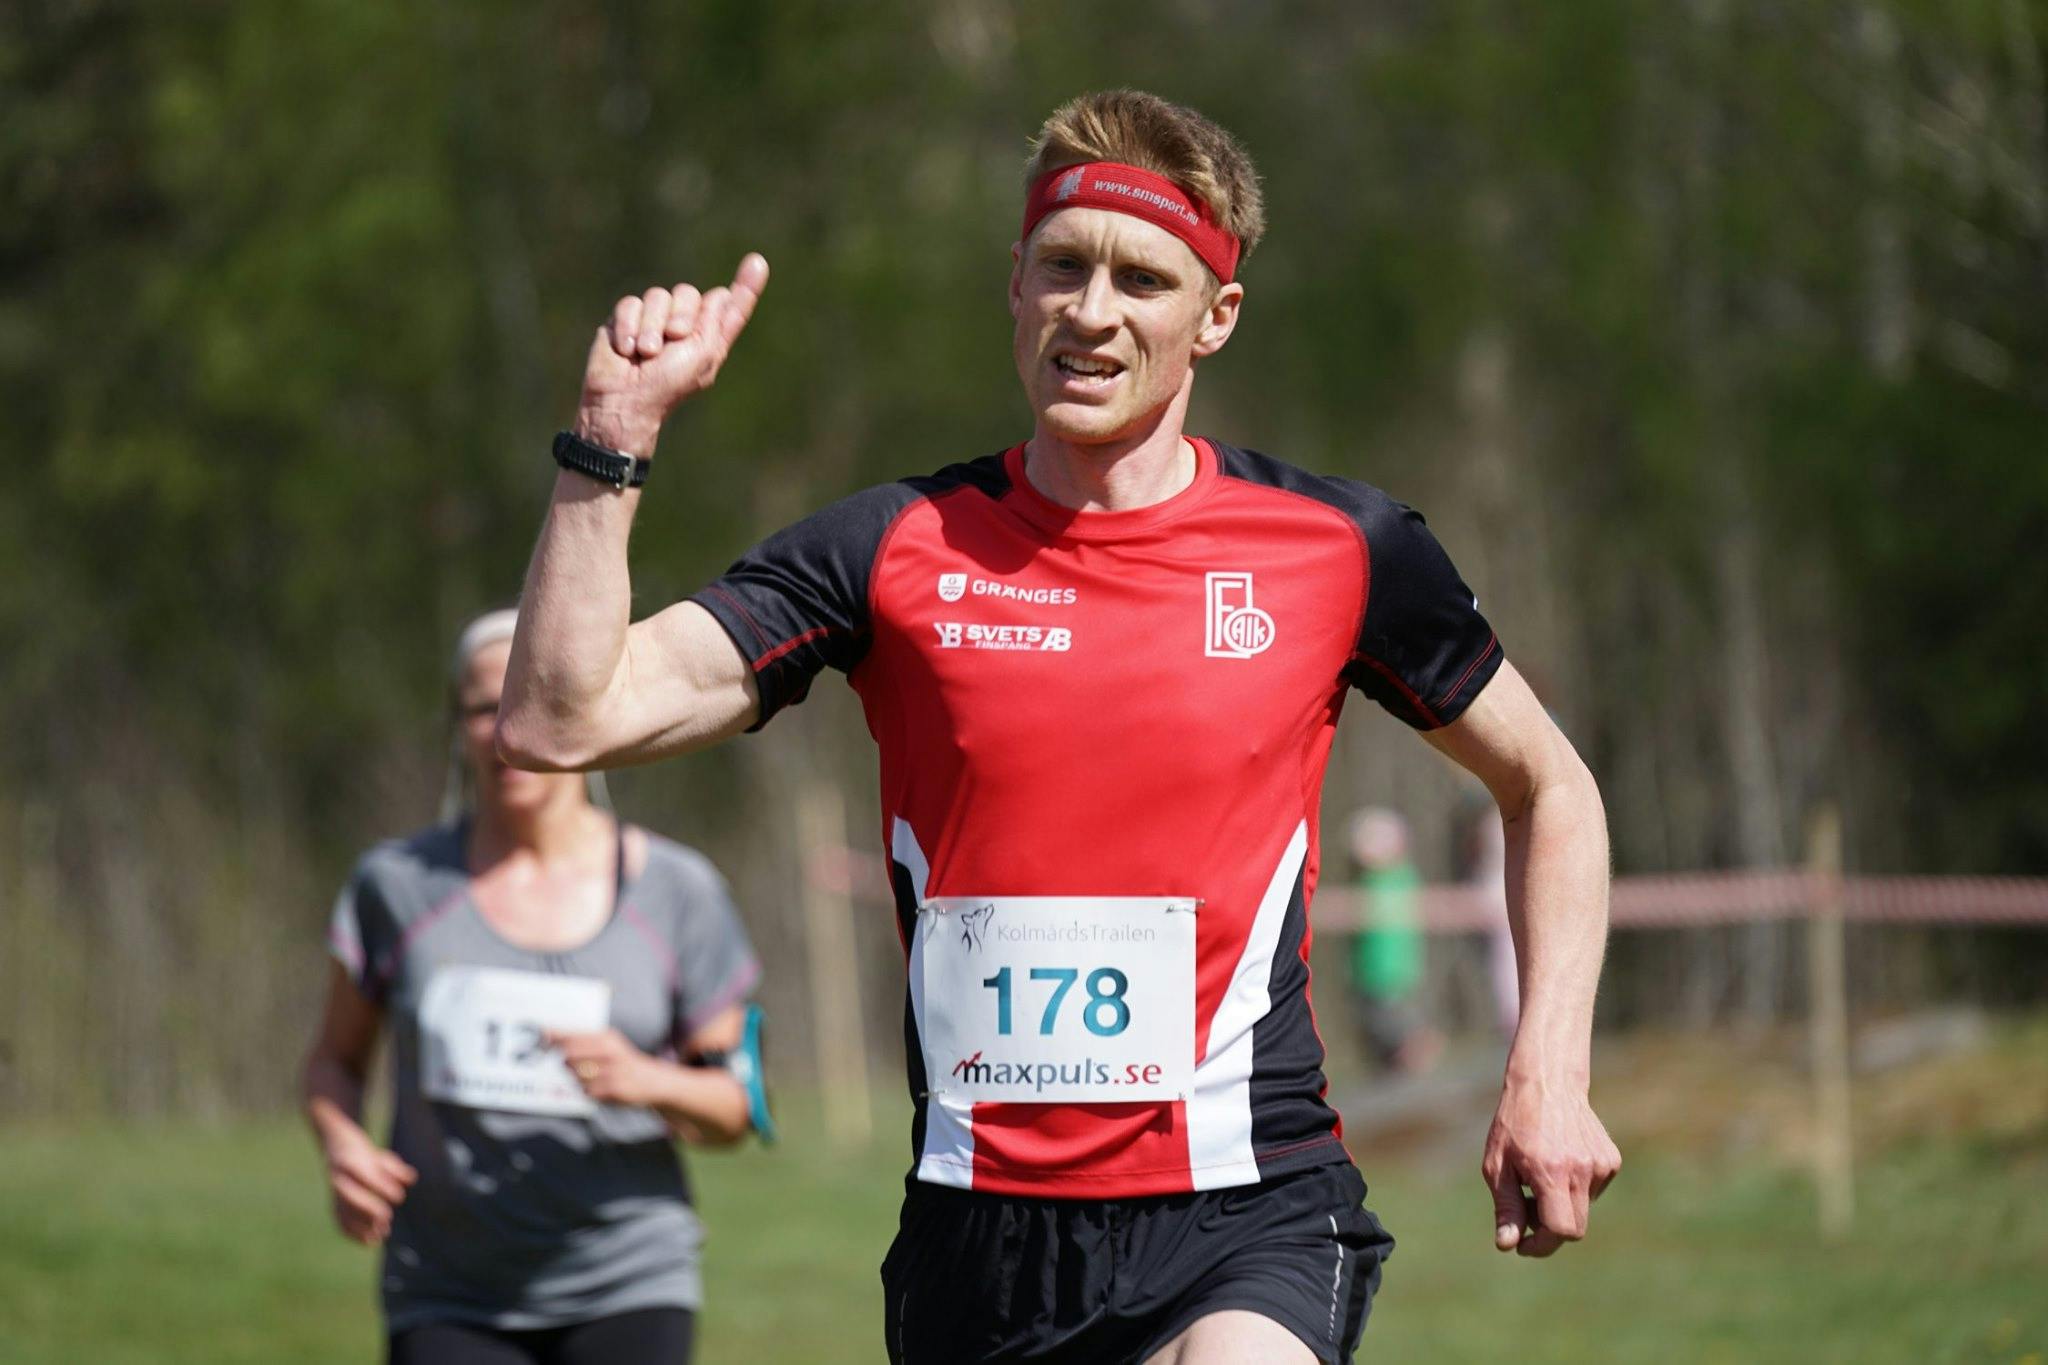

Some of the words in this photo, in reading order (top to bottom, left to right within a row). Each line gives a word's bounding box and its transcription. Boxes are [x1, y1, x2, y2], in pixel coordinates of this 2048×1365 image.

[972, 579, 1077, 604] GRÄNGES
[966, 624, 1042, 642] SVETS
[1040, 627, 1072, 652] AB
[997, 920, 1156, 942] KolmårdsTrailen
[983, 966, 1131, 1037] 178
[961, 1057, 1163, 1092] maxpuls.se
